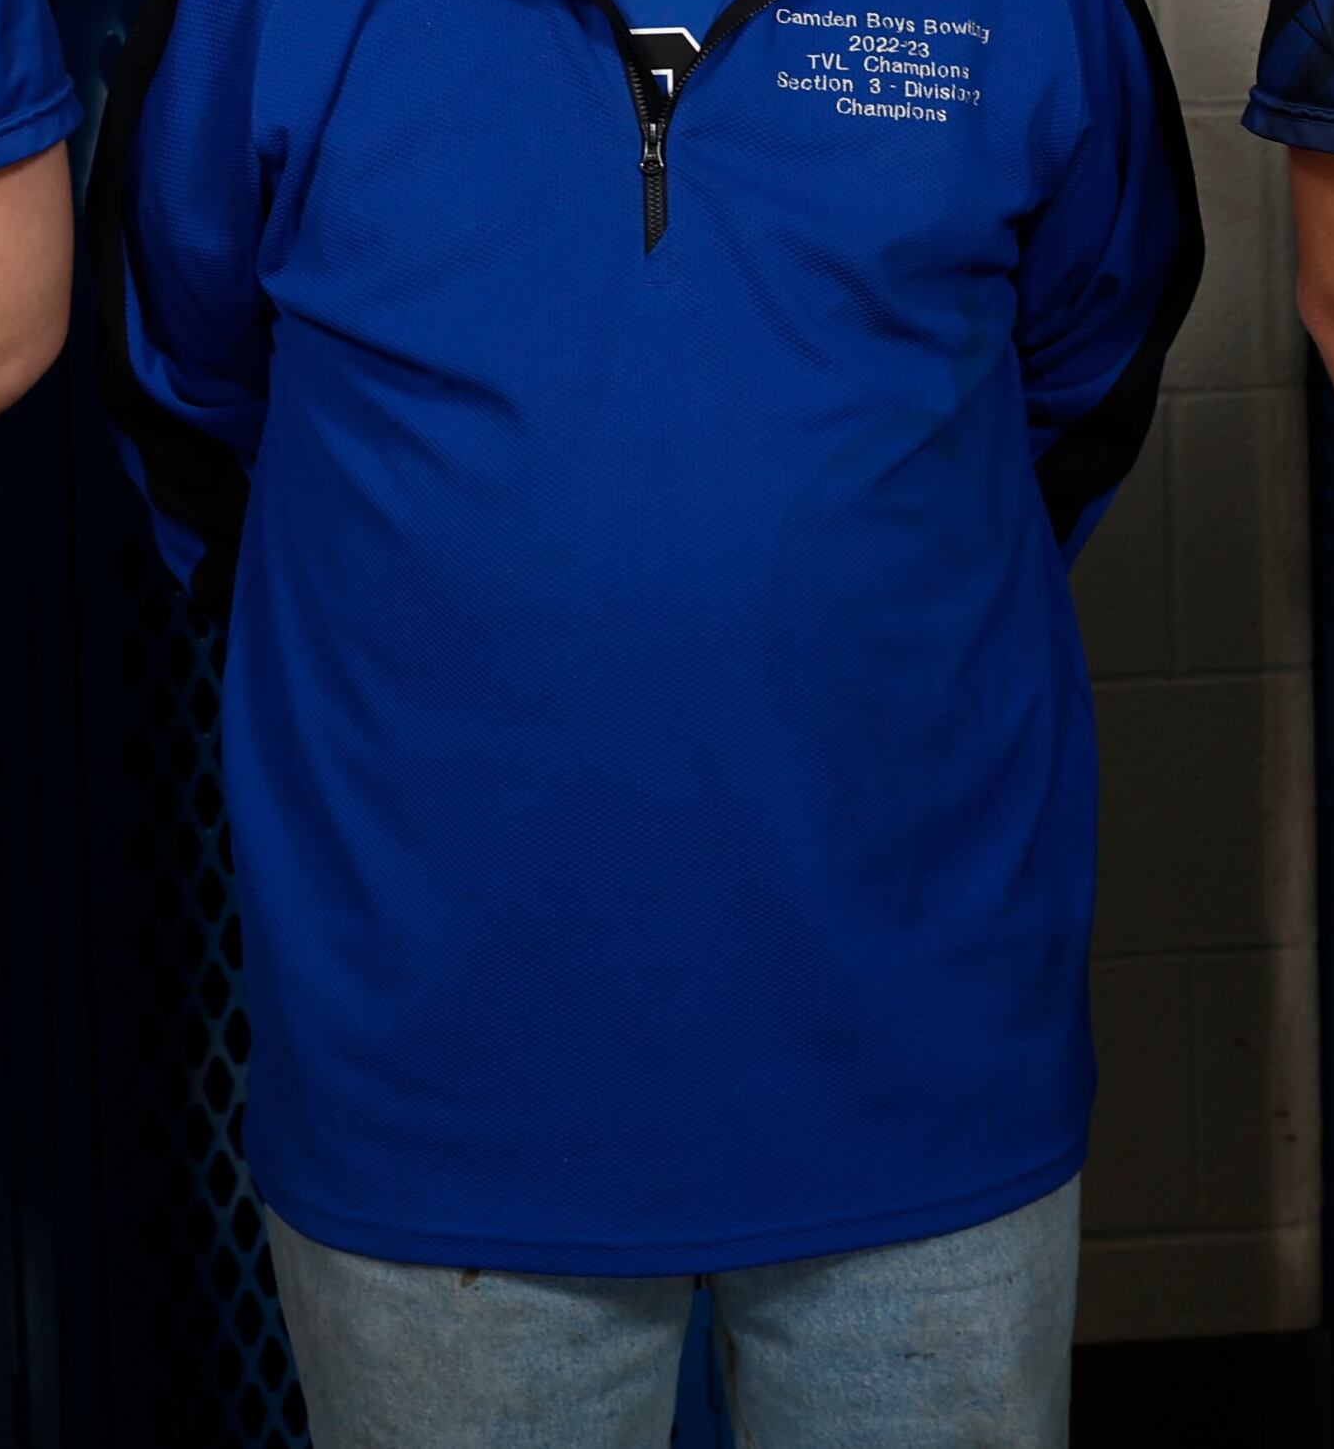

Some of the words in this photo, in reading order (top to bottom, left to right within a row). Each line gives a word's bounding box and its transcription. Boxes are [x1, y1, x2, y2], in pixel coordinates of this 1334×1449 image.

[775, 8, 858, 28] Camden
[866, 12, 915, 34] Boys
[848, 35, 931, 58] 2022-23
[806, 53, 850, 72] TVL
[863, 55, 970, 80] Champions
[776, 71, 854, 93] Section
[869, 78, 881, 94] 3
[836, 97, 948, 123] Champions
